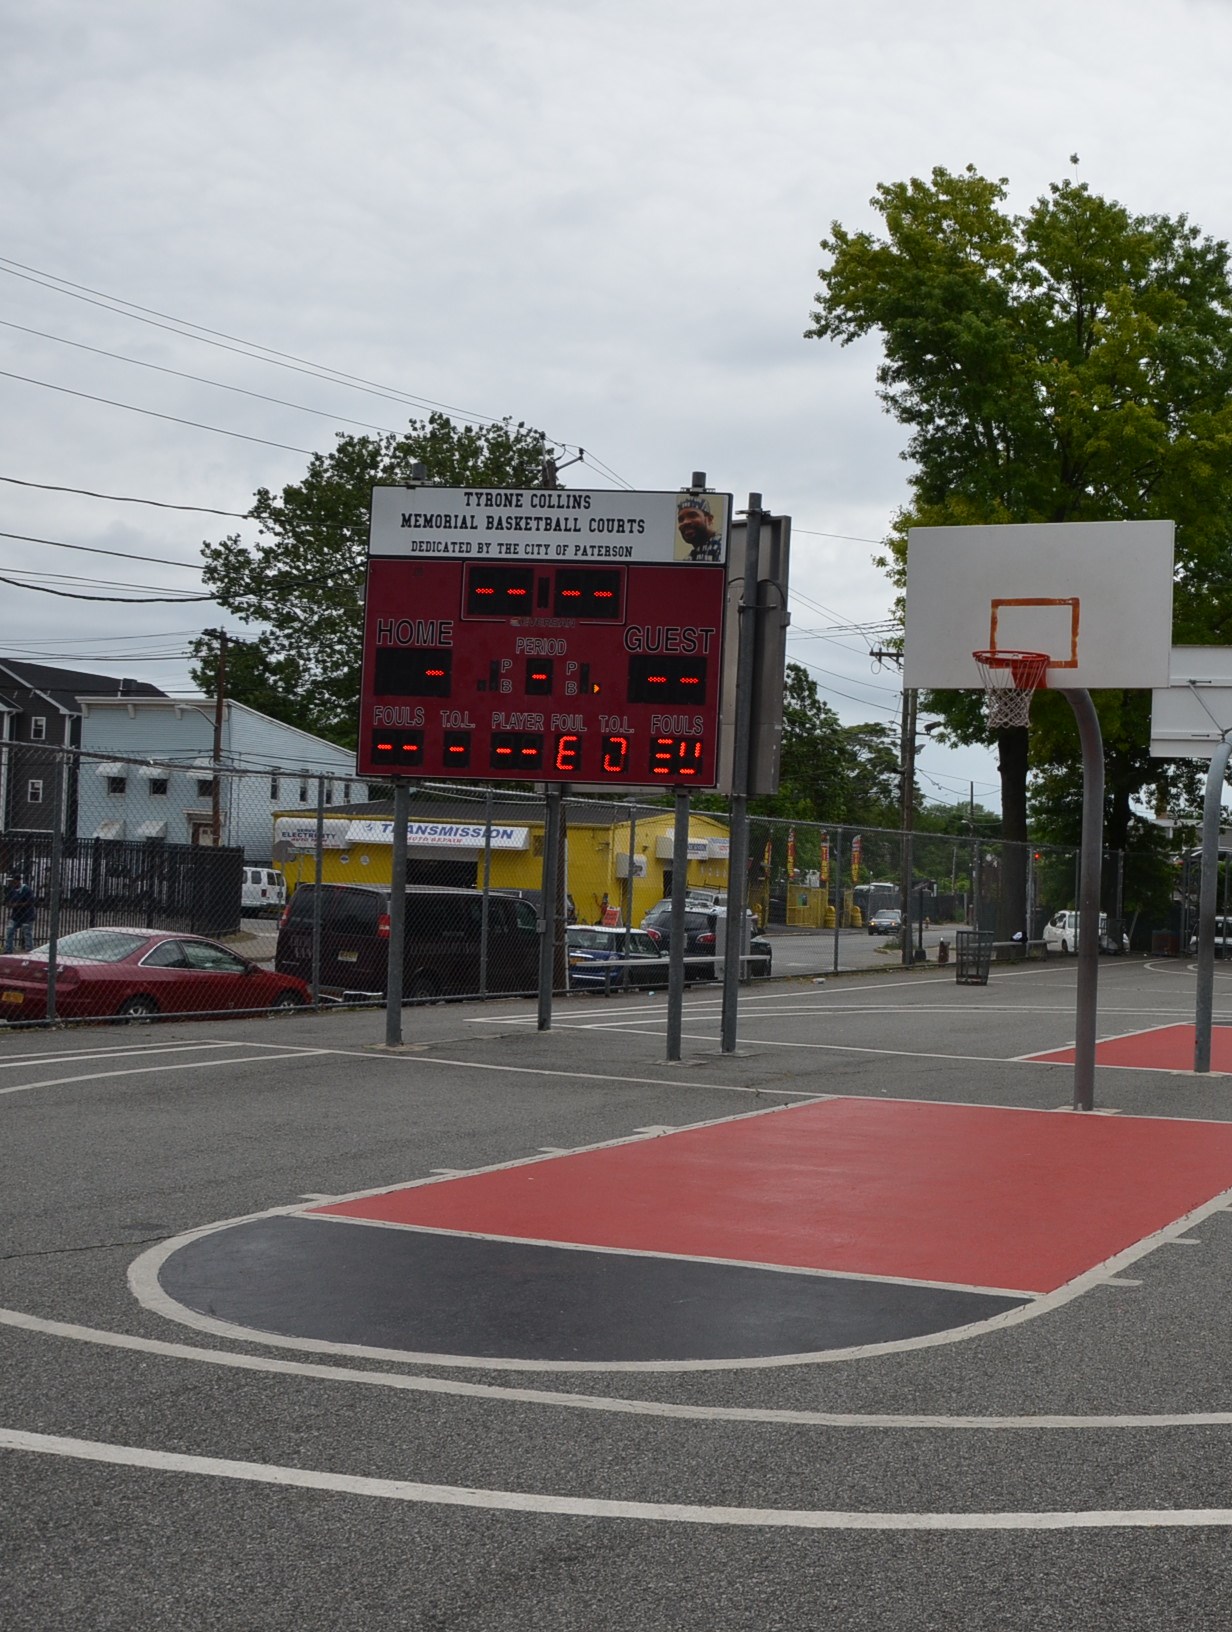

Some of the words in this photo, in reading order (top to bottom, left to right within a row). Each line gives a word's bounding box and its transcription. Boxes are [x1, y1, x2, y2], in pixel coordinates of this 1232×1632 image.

[463, 491, 524, 508] TYRONE
[530, 493, 592, 510] COLLINS
[400, 512, 479, 530] MEMORIAL
[485, 515, 582, 533] BASKETBALL
[588, 517, 646, 535] COURTS
[410, 540, 472, 553] DEDICATED
[476, 542, 492, 554] BY
[496, 542, 520, 555] THE
[524, 543, 551, 556] CITY
[555, 544, 569, 556] OF
[573, 544, 634, 558] PATERSON
[376, 618, 454, 647] HOME
[623, 624, 716, 654] GUEST
[515, 637, 567, 656] PERIOD
[501, 658, 513, 673] P
[566, 661, 578, 676] P
[500, 679, 513, 693] B
[565, 681, 577, 695] B
[373, 706, 425, 727] FOULS
[439, 710, 476, 729] T.O.L.
[491, 711, 545, 731] PLAYER
[551, 713, 587, 732] FOUL
[599, 714, 635, 734] T.O.L.
[651, 714, 704, 735] FOULS
[281, 831, 336, 839] ELECTRIITY
[381, 823, 514, 840] TANSMISSON
